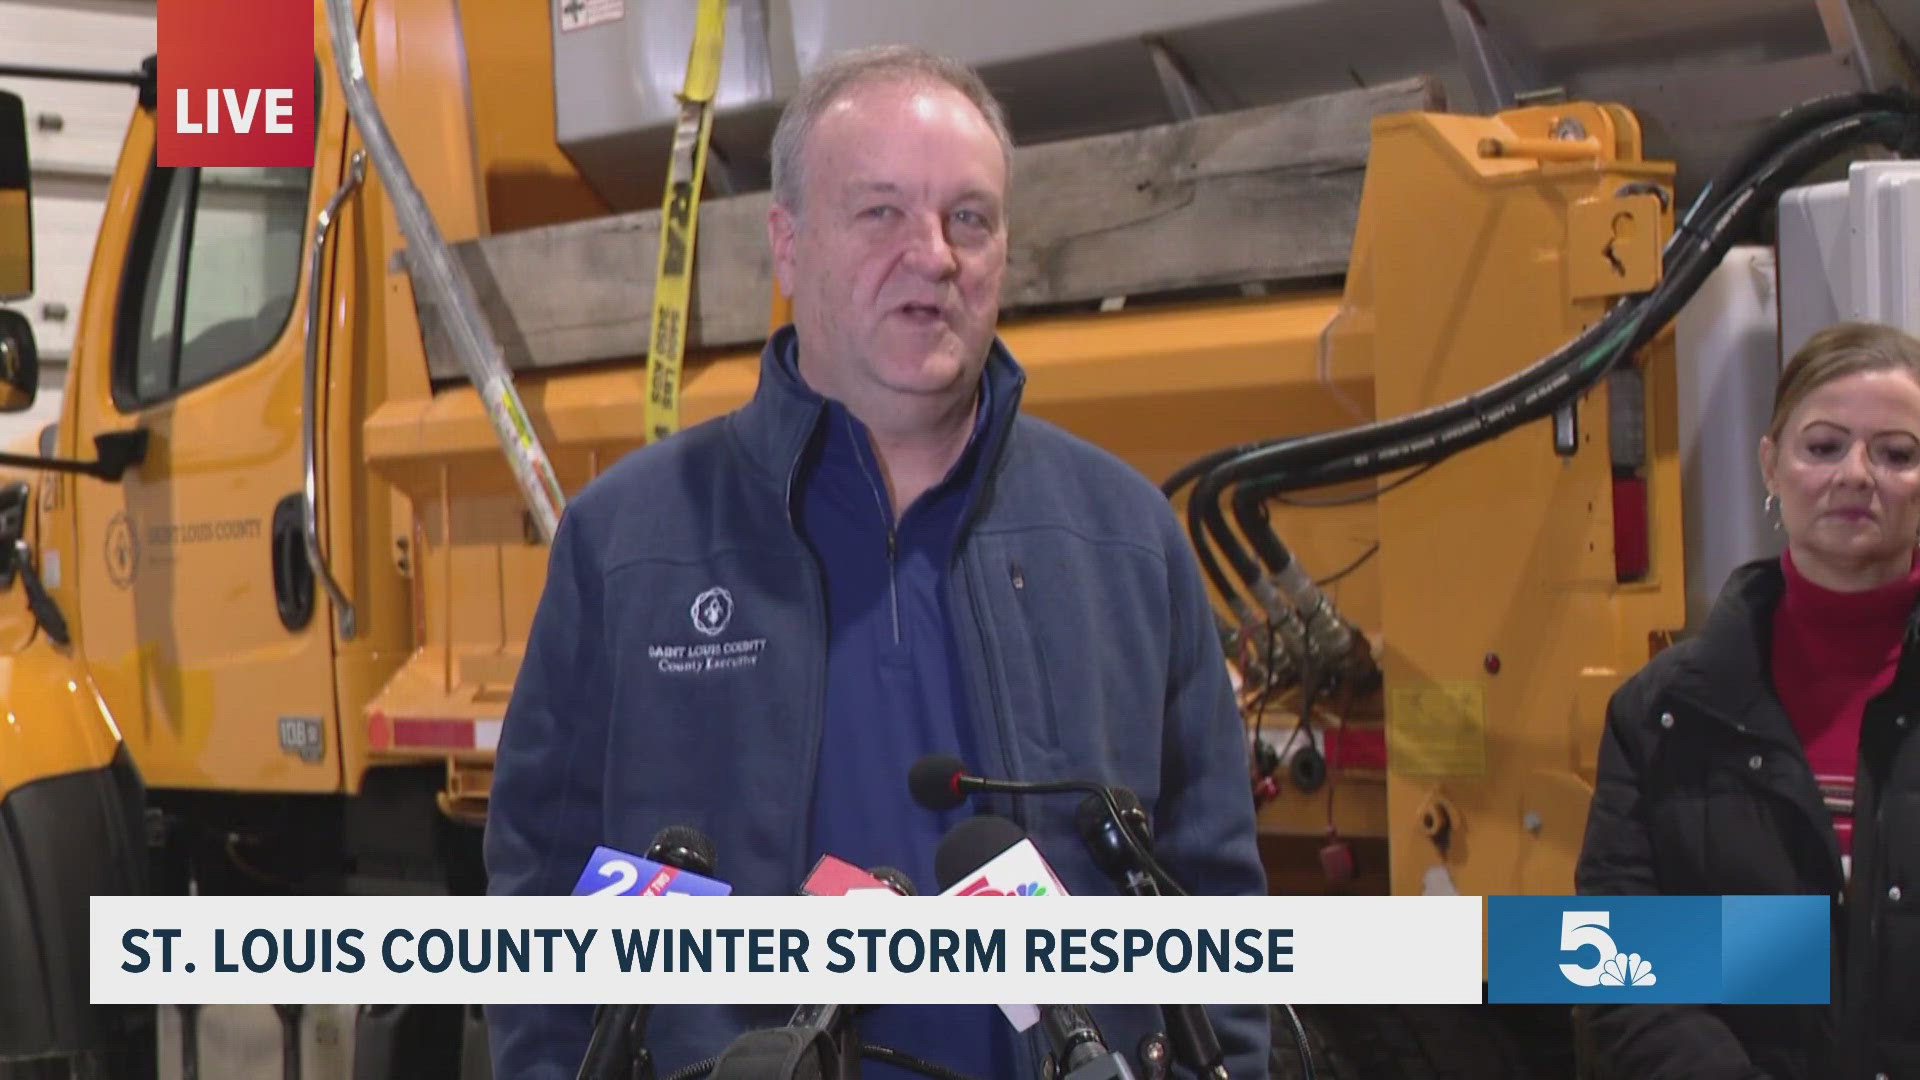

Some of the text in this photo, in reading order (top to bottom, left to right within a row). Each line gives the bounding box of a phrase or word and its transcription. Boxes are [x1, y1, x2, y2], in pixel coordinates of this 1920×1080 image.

[215, 518, 262, 541] COUNTY
[648, 638, 767, 659] SAINT LOUIS COUNTY
[658, 656, 757, 675] County Executive
